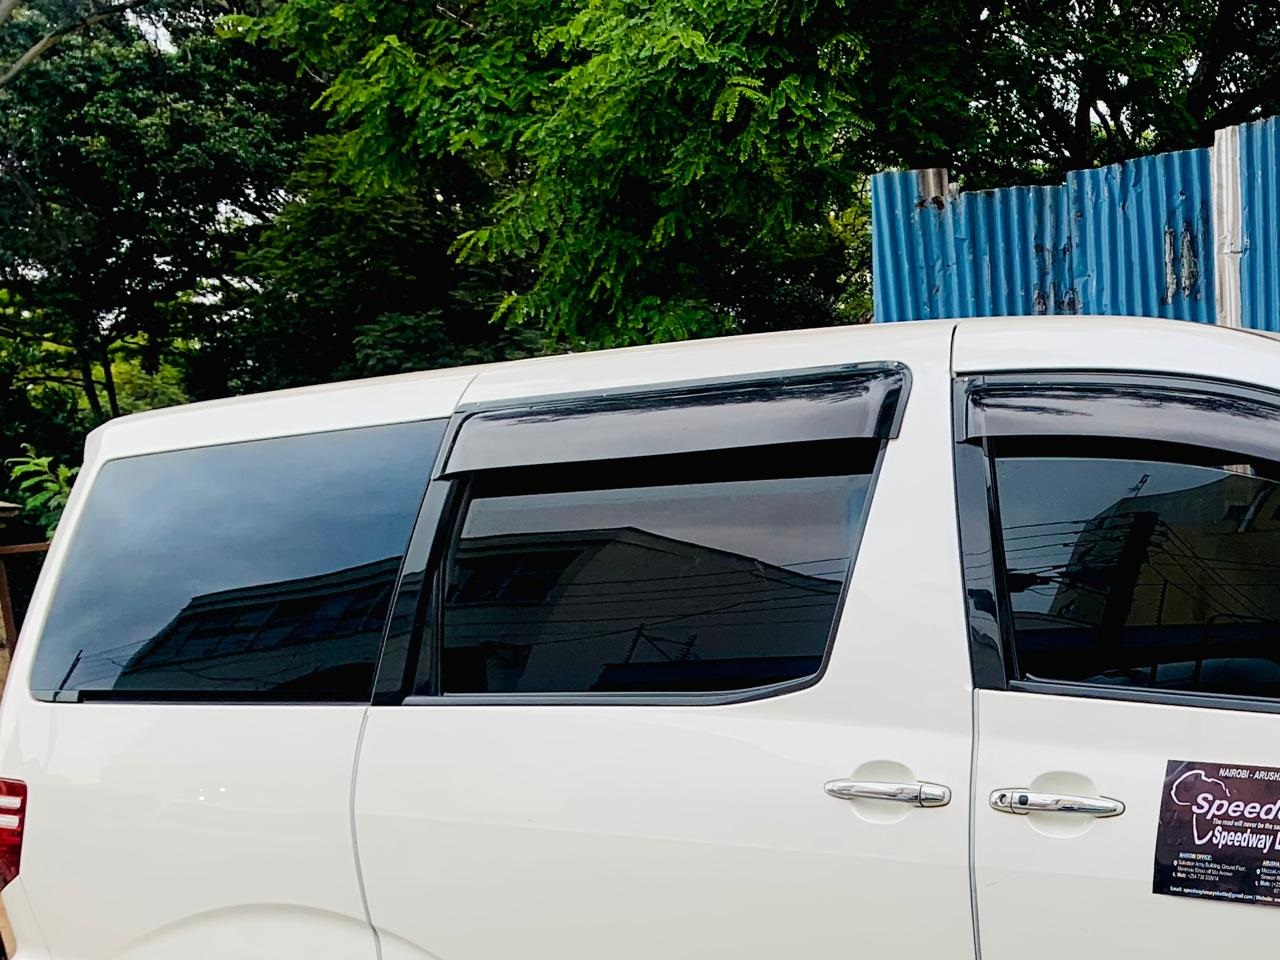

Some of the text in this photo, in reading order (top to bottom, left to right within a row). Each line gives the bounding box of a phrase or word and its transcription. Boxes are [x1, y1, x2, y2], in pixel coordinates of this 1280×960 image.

[1219, 768, 1249, 778] NAIROBI
[1212, 826, 1273, 853] Speedway
[1262, 860, 1280, 868] ARUSHA
